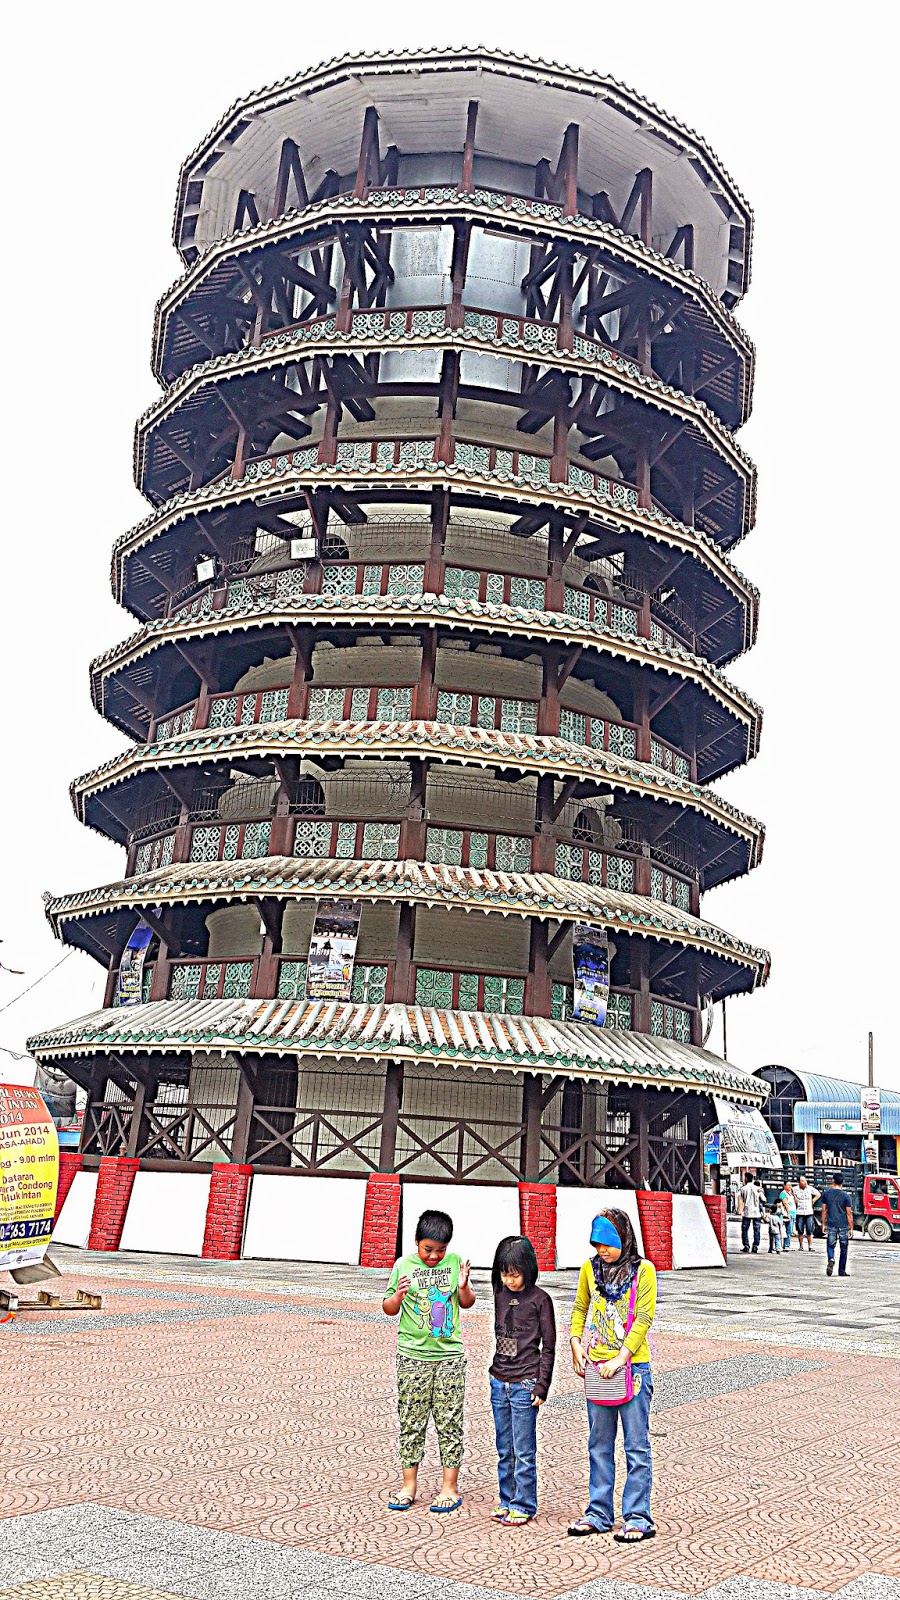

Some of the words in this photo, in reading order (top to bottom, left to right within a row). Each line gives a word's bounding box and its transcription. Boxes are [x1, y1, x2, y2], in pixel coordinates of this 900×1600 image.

[8, 1100, 38, 1109] INTAN
[24, 1126, 50, 1136] 2014
[19, 1155, 36, 1164] 9.00
[38, 1154, 56, 1162] mlm
[2, 1174, 34, 1184] Dataran
[18, 1181, 53, 1190] Condong
[22, 1191, 42, 1199] Intan
[29, 1220, 51, 1235] 7174
[412, 1269, 430, 1278] SCARE
[417, 1278, 428, 1287] WE
